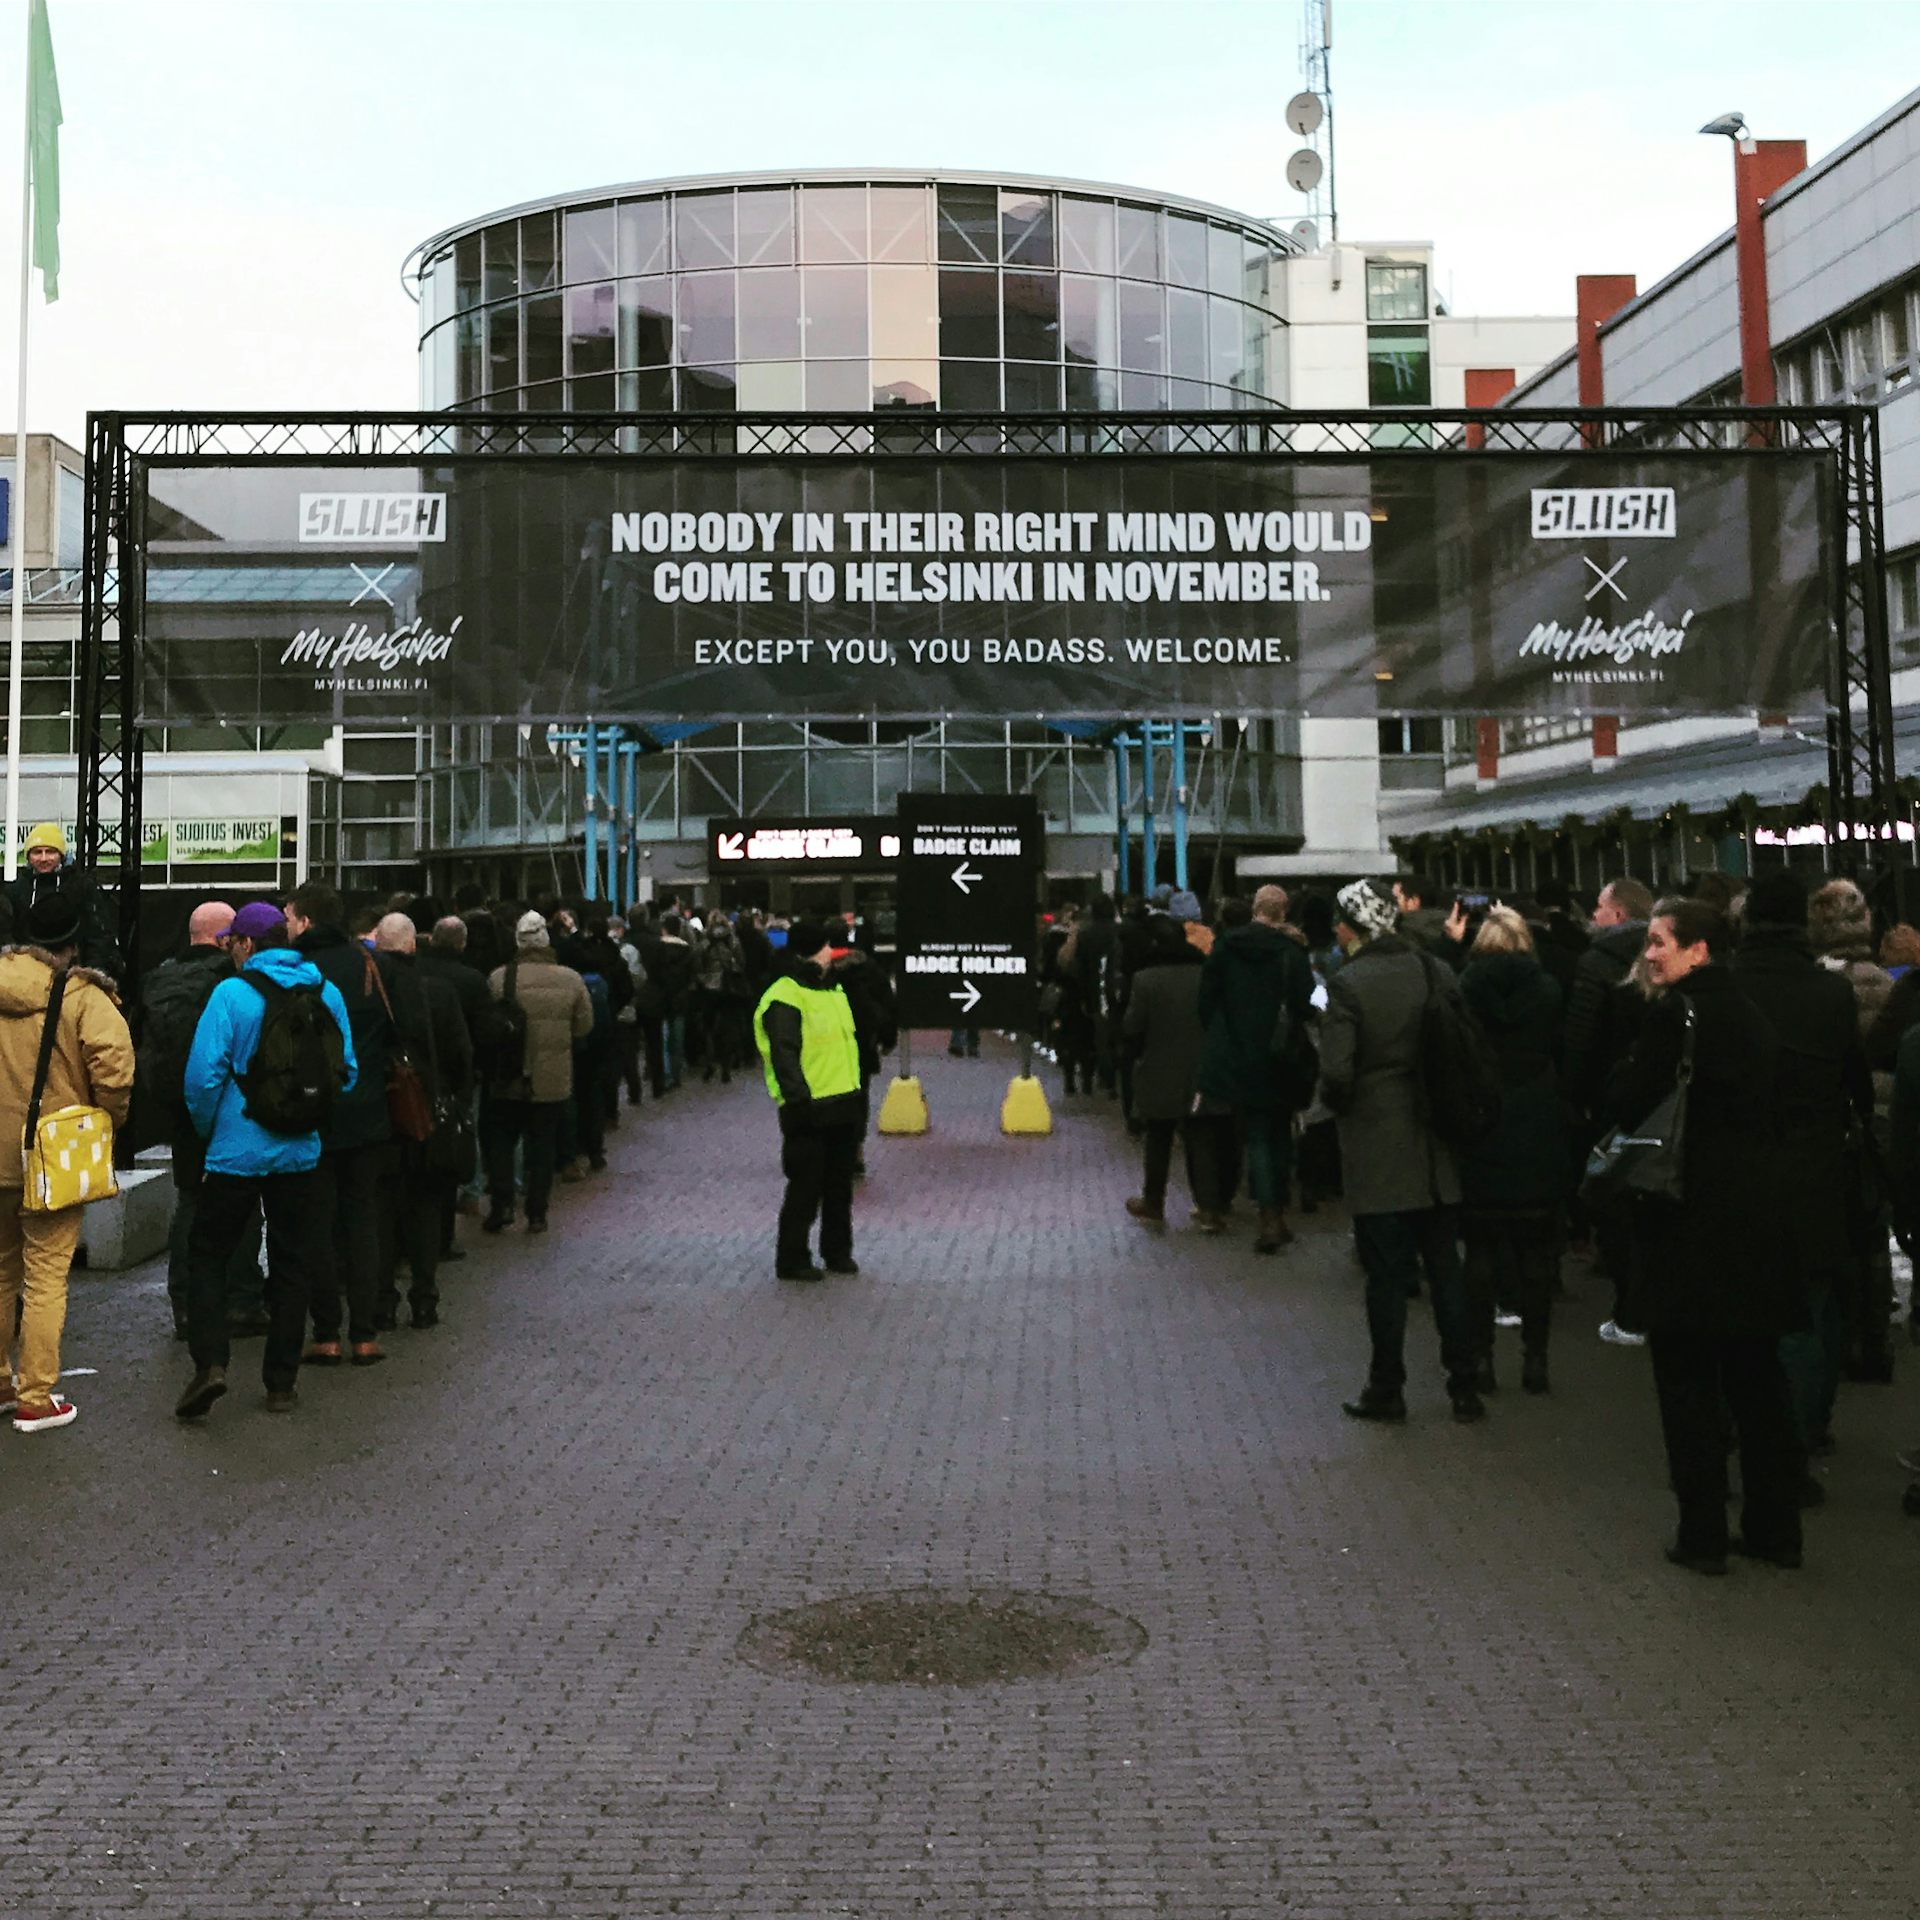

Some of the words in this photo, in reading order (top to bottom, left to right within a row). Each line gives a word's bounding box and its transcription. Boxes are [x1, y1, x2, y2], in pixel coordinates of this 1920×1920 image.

[304, 497, 442, 537] SLUSH
[1537, 492, 1669, 532] SLUSH
[611, 511, 784, 553] NOBODY
[791, 512, 835, 552] IN
[843, 512, 965, 552] THEIR
[974, 512, 1098, 552] RIGHT
[1107, 511, 1216, 552] MIND
[1224, 510, 1372, 552] WOULD
[653, 560, 773, 602] COME
[781, 560, 835, 602] TO
[845, 561, 1033, 602] HELSINKI
[1043, 561, 1085, 601] IN
[1095, 560, 1331, 602] NOVEMBER.
[694, 638, 815, 665] EXCEPT
[824, 638, 897, 667] YOU,
[907, 638, 970, 664] YOU
[982, 637, 1115, 664] BADASS.
[1125, 637, 1291, 663] WELCOME.
[313, 677, 429, 691] MYHELSINKI.FI
[1551, 668, 1665, 685] MYHELSINKI.FI
[176, 822, 226, 842] SIJOITUS
[232, 821, 273, 841] INVEST
[912, 837, 967, 855] BADGE
[968, 837, 1022, 856] CLAIM
[904, 955, 960, 974] BADGE
[961, 955, 1027, 974] HOLDER
